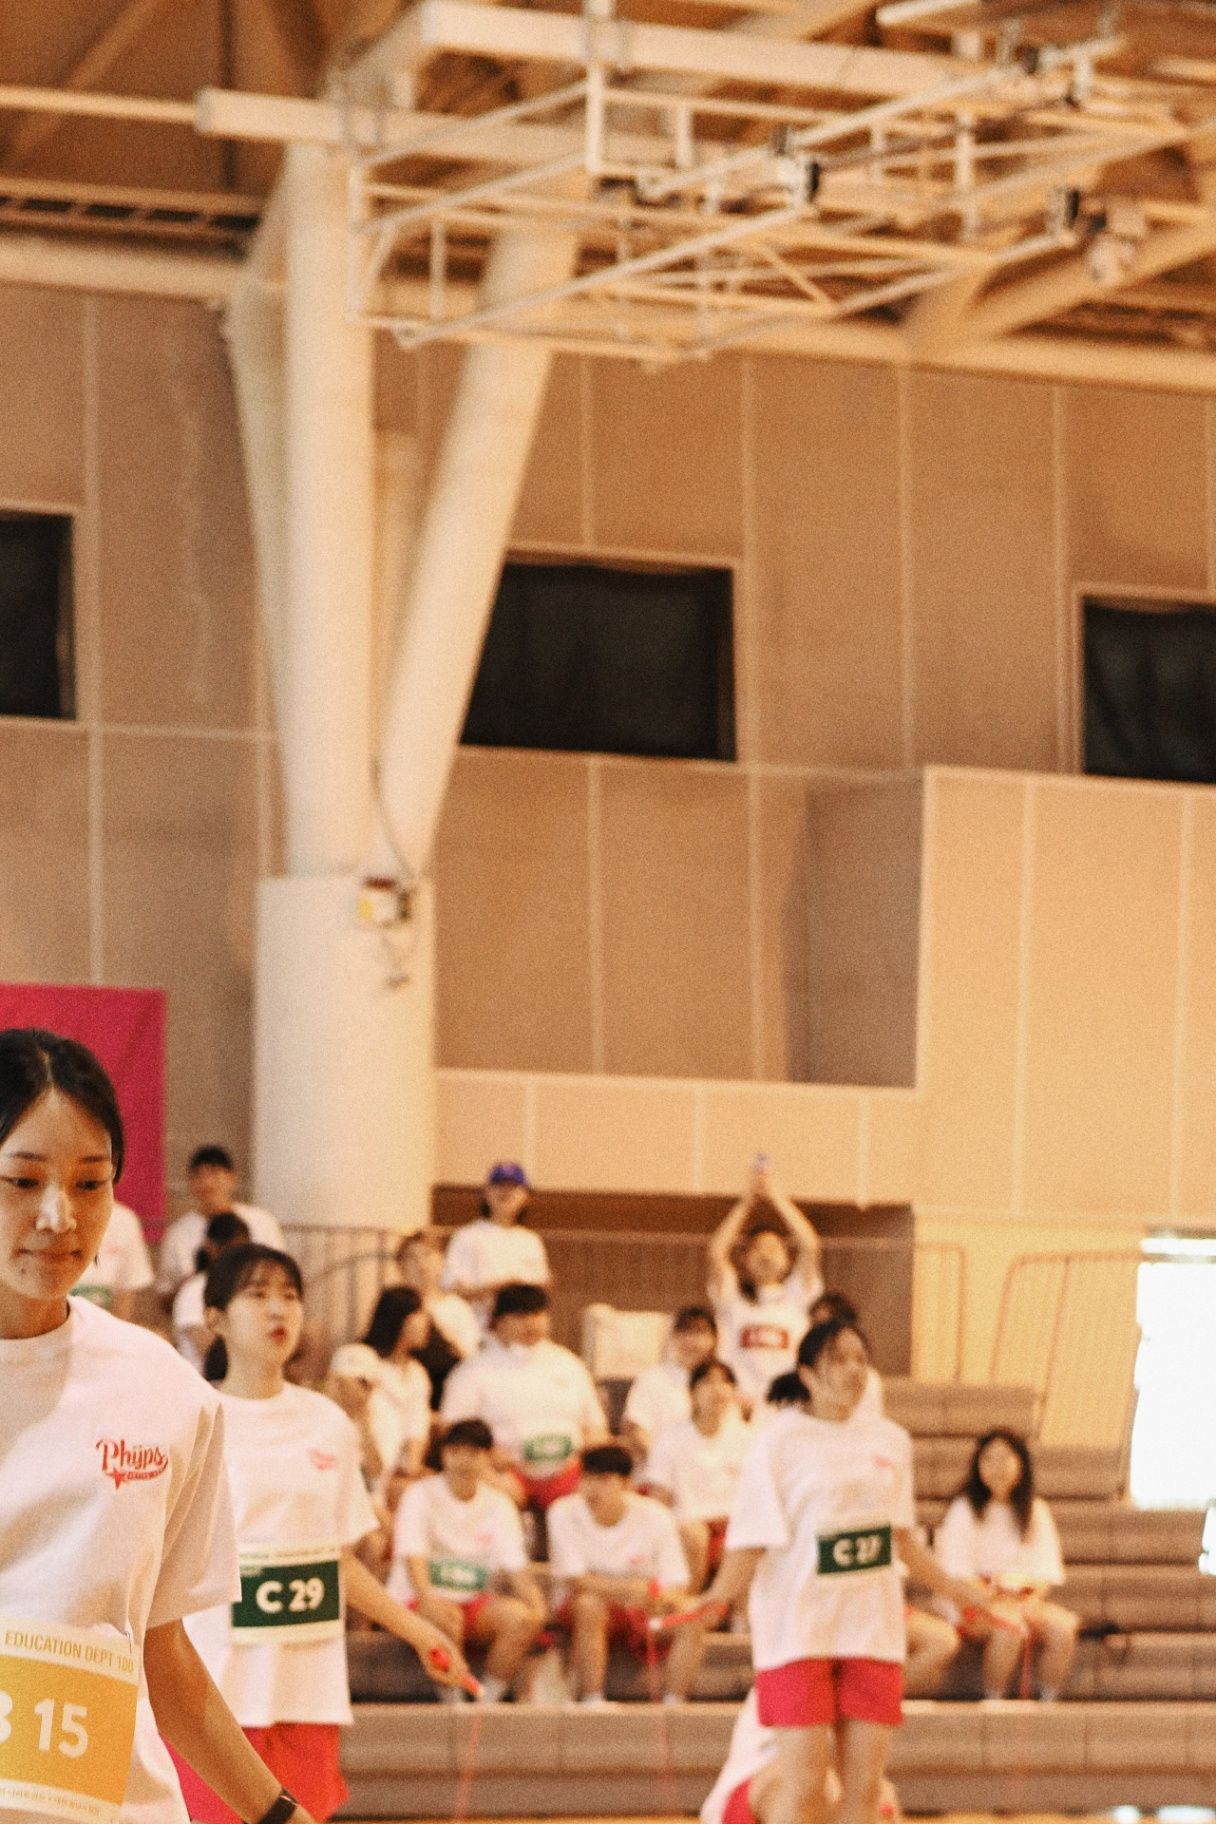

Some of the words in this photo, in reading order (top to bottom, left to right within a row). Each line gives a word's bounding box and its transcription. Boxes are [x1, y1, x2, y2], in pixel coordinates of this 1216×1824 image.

[832, 1538, 854, 1567] C
[255, 1580, 284, 1614] C
[287, 1577, 325, 1612] 29
[4, 1630, 82, 1659] EDUCATION
[84, 1646, 113, 1667] DEPT
[33, 1698, 89, 1759] 15
